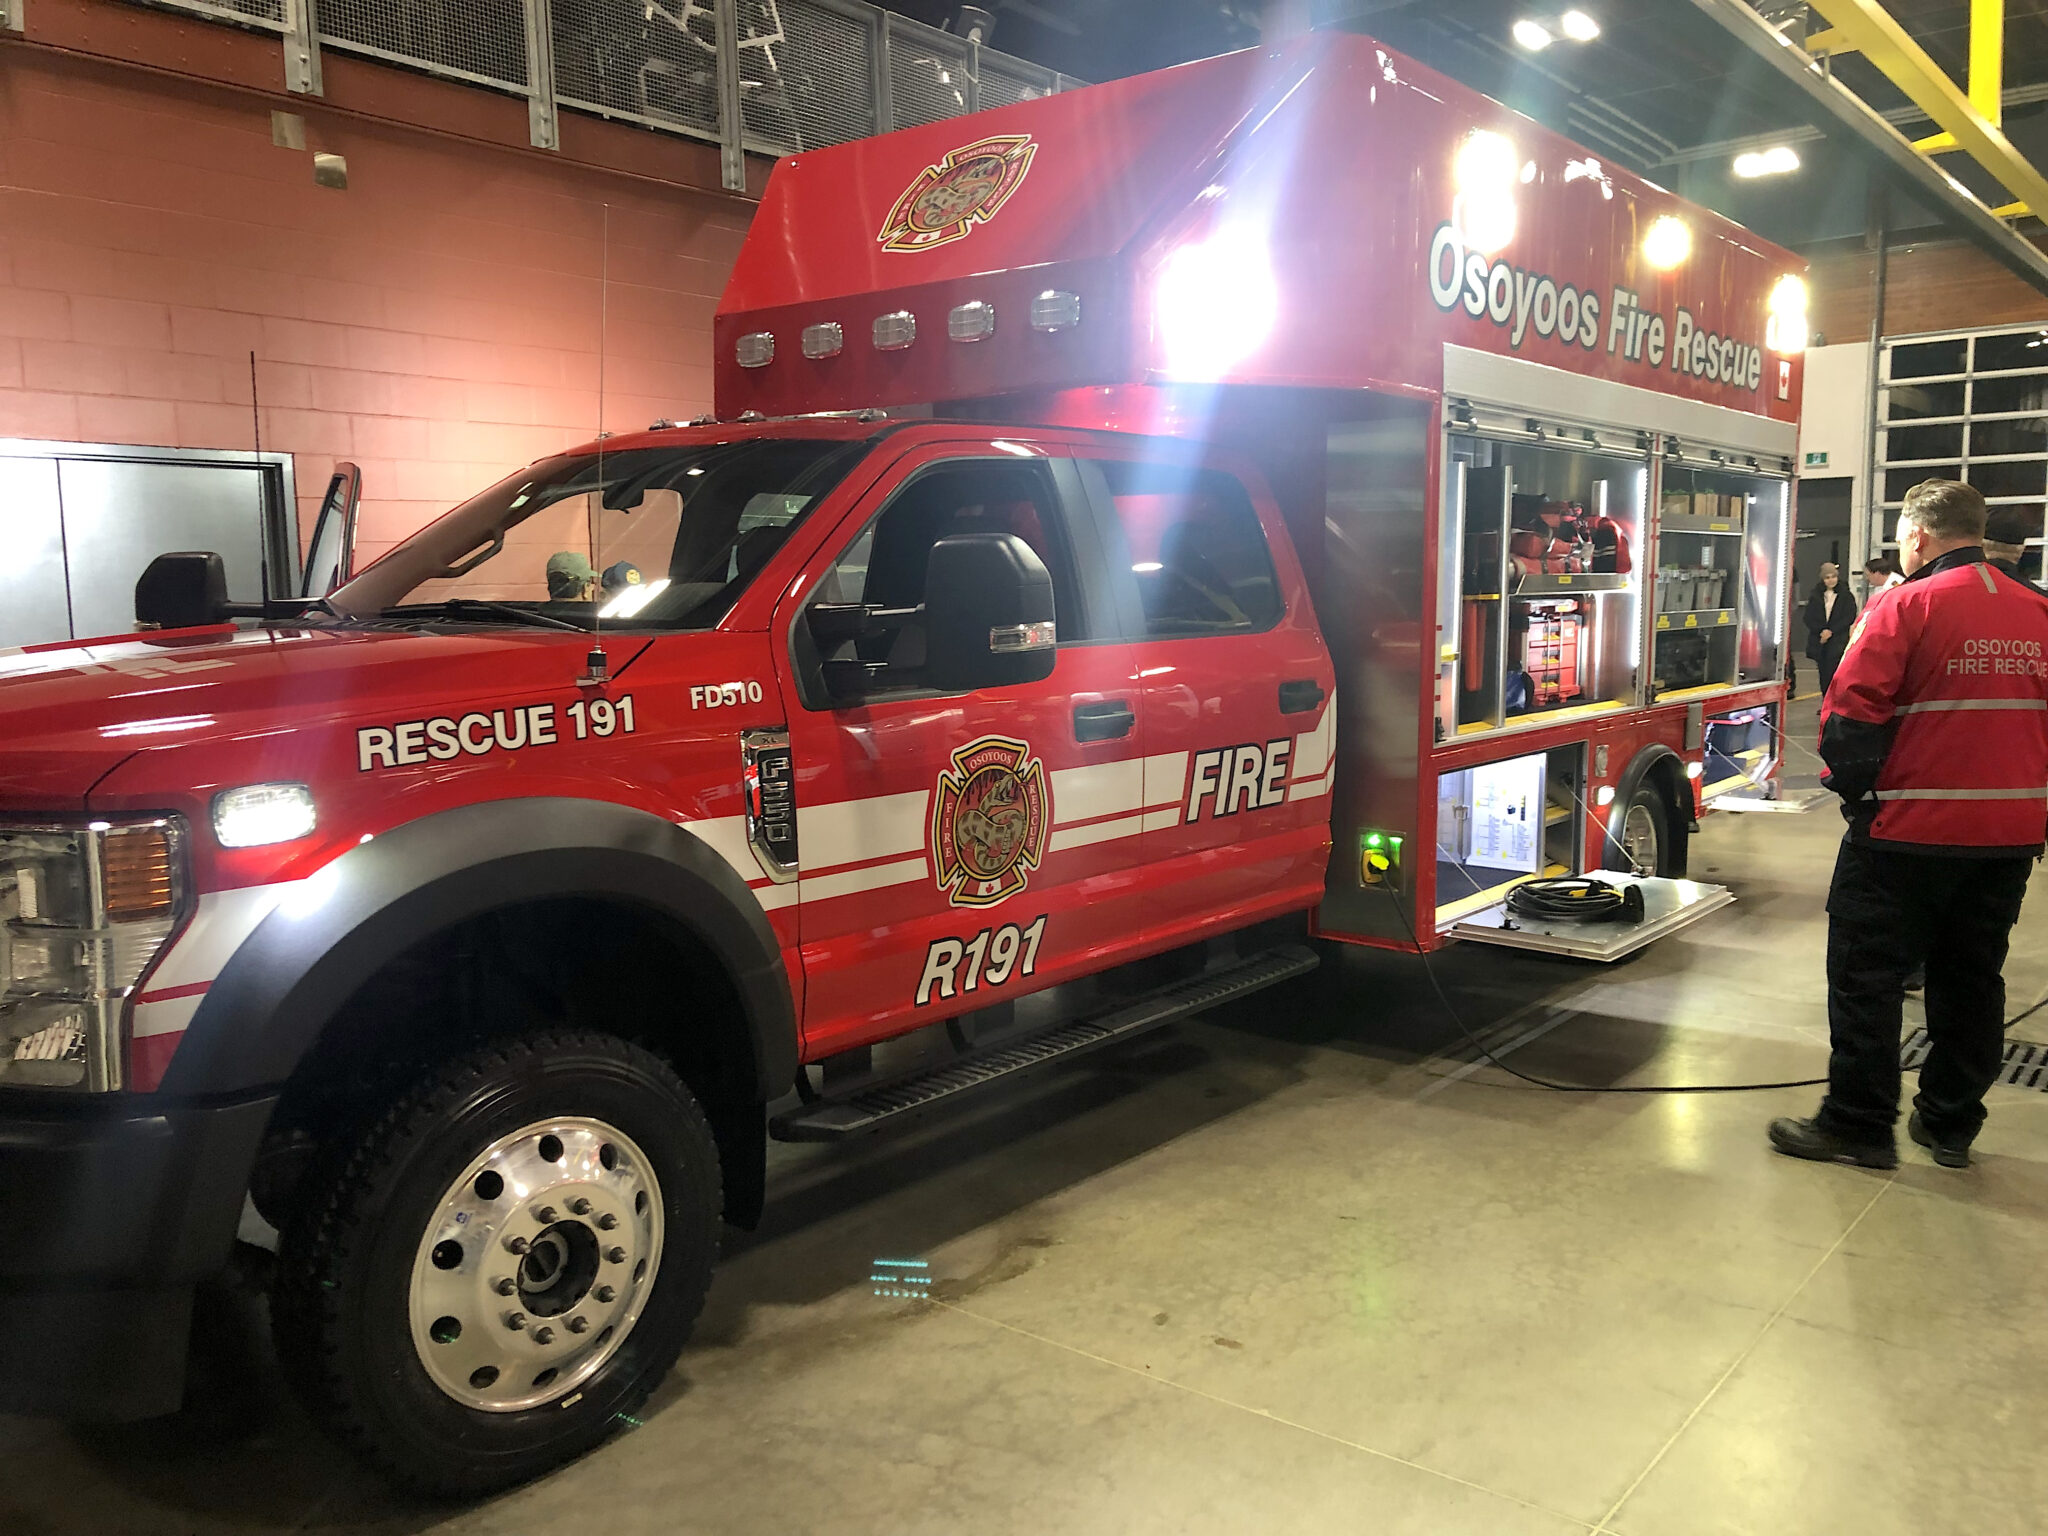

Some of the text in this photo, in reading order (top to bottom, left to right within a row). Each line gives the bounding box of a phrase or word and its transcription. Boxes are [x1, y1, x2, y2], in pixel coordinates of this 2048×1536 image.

[1429, 222, 1762, 391] Osoyoos Fire Rescue
[1946, 658, 2048, 678] FIRE RESCUE
[1964, 639, 2041, 657] OSOYOOS
[689, 681, 763, 711] FD510
[357, 695, 636, 772] RESCUE 191
[969, 751, 1013, 769] OSOYOOS
[761, 757, 792, 842] F550
[1186, 738, 1292, 825] FIRE
[943, 802, 953, 858] FIRE
[1028, 784, 1040, 847] RESCUE
[914, 913, 1048, 1006] R191
